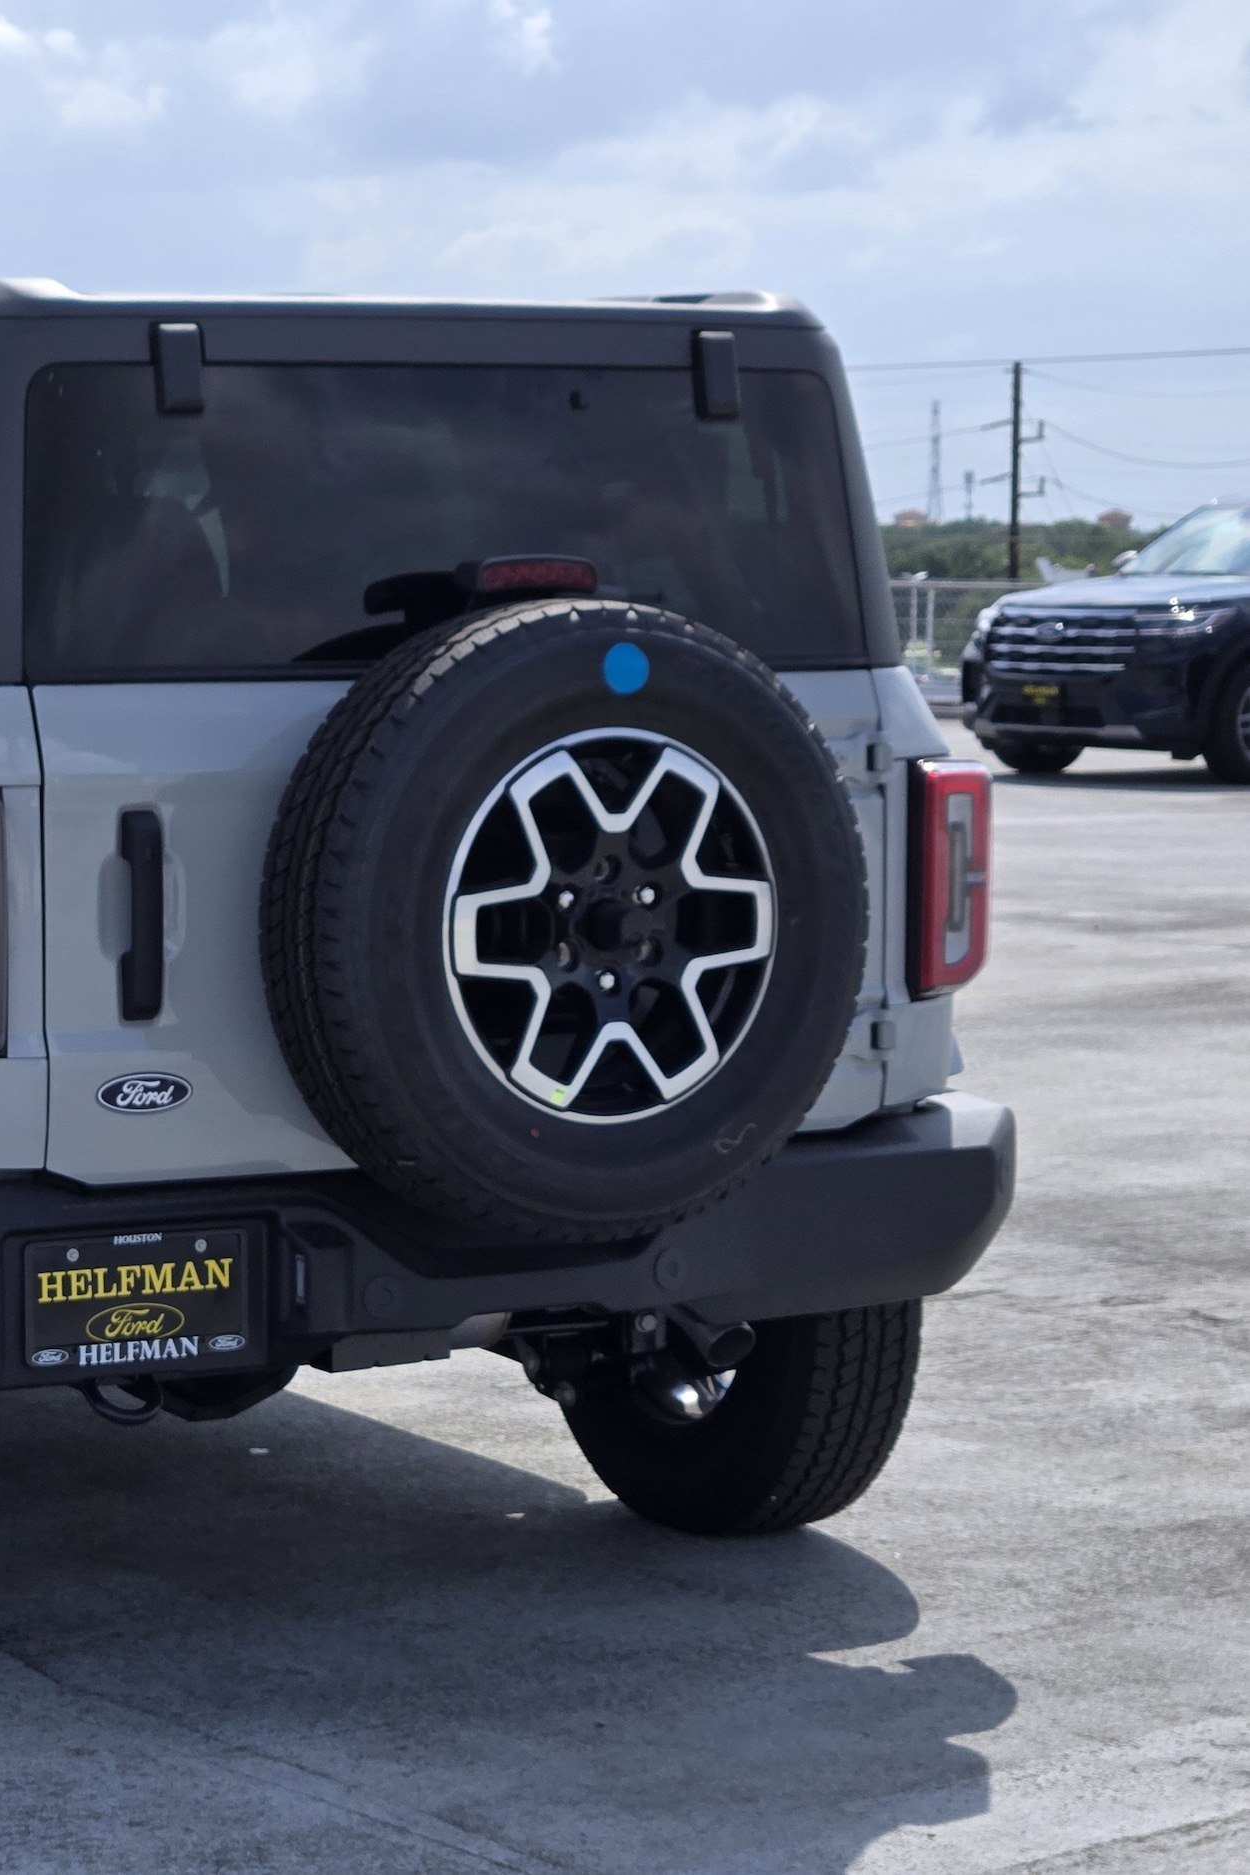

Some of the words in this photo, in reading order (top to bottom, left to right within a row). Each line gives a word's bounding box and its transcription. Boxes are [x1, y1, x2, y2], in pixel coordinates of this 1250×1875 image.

[116, 1080, 175, 1106] Ford
[113, 1232, 162, 1245] HOUSTON
[38, 1258, 233, 1303] HELFMAN
[104, 1308, 166, 1338] Ford
[79, 1336, 199, 1366] HELFMAN
[215, 1336, 239, 1348] Ford
[38, 1351, 63, 1362] Ford
